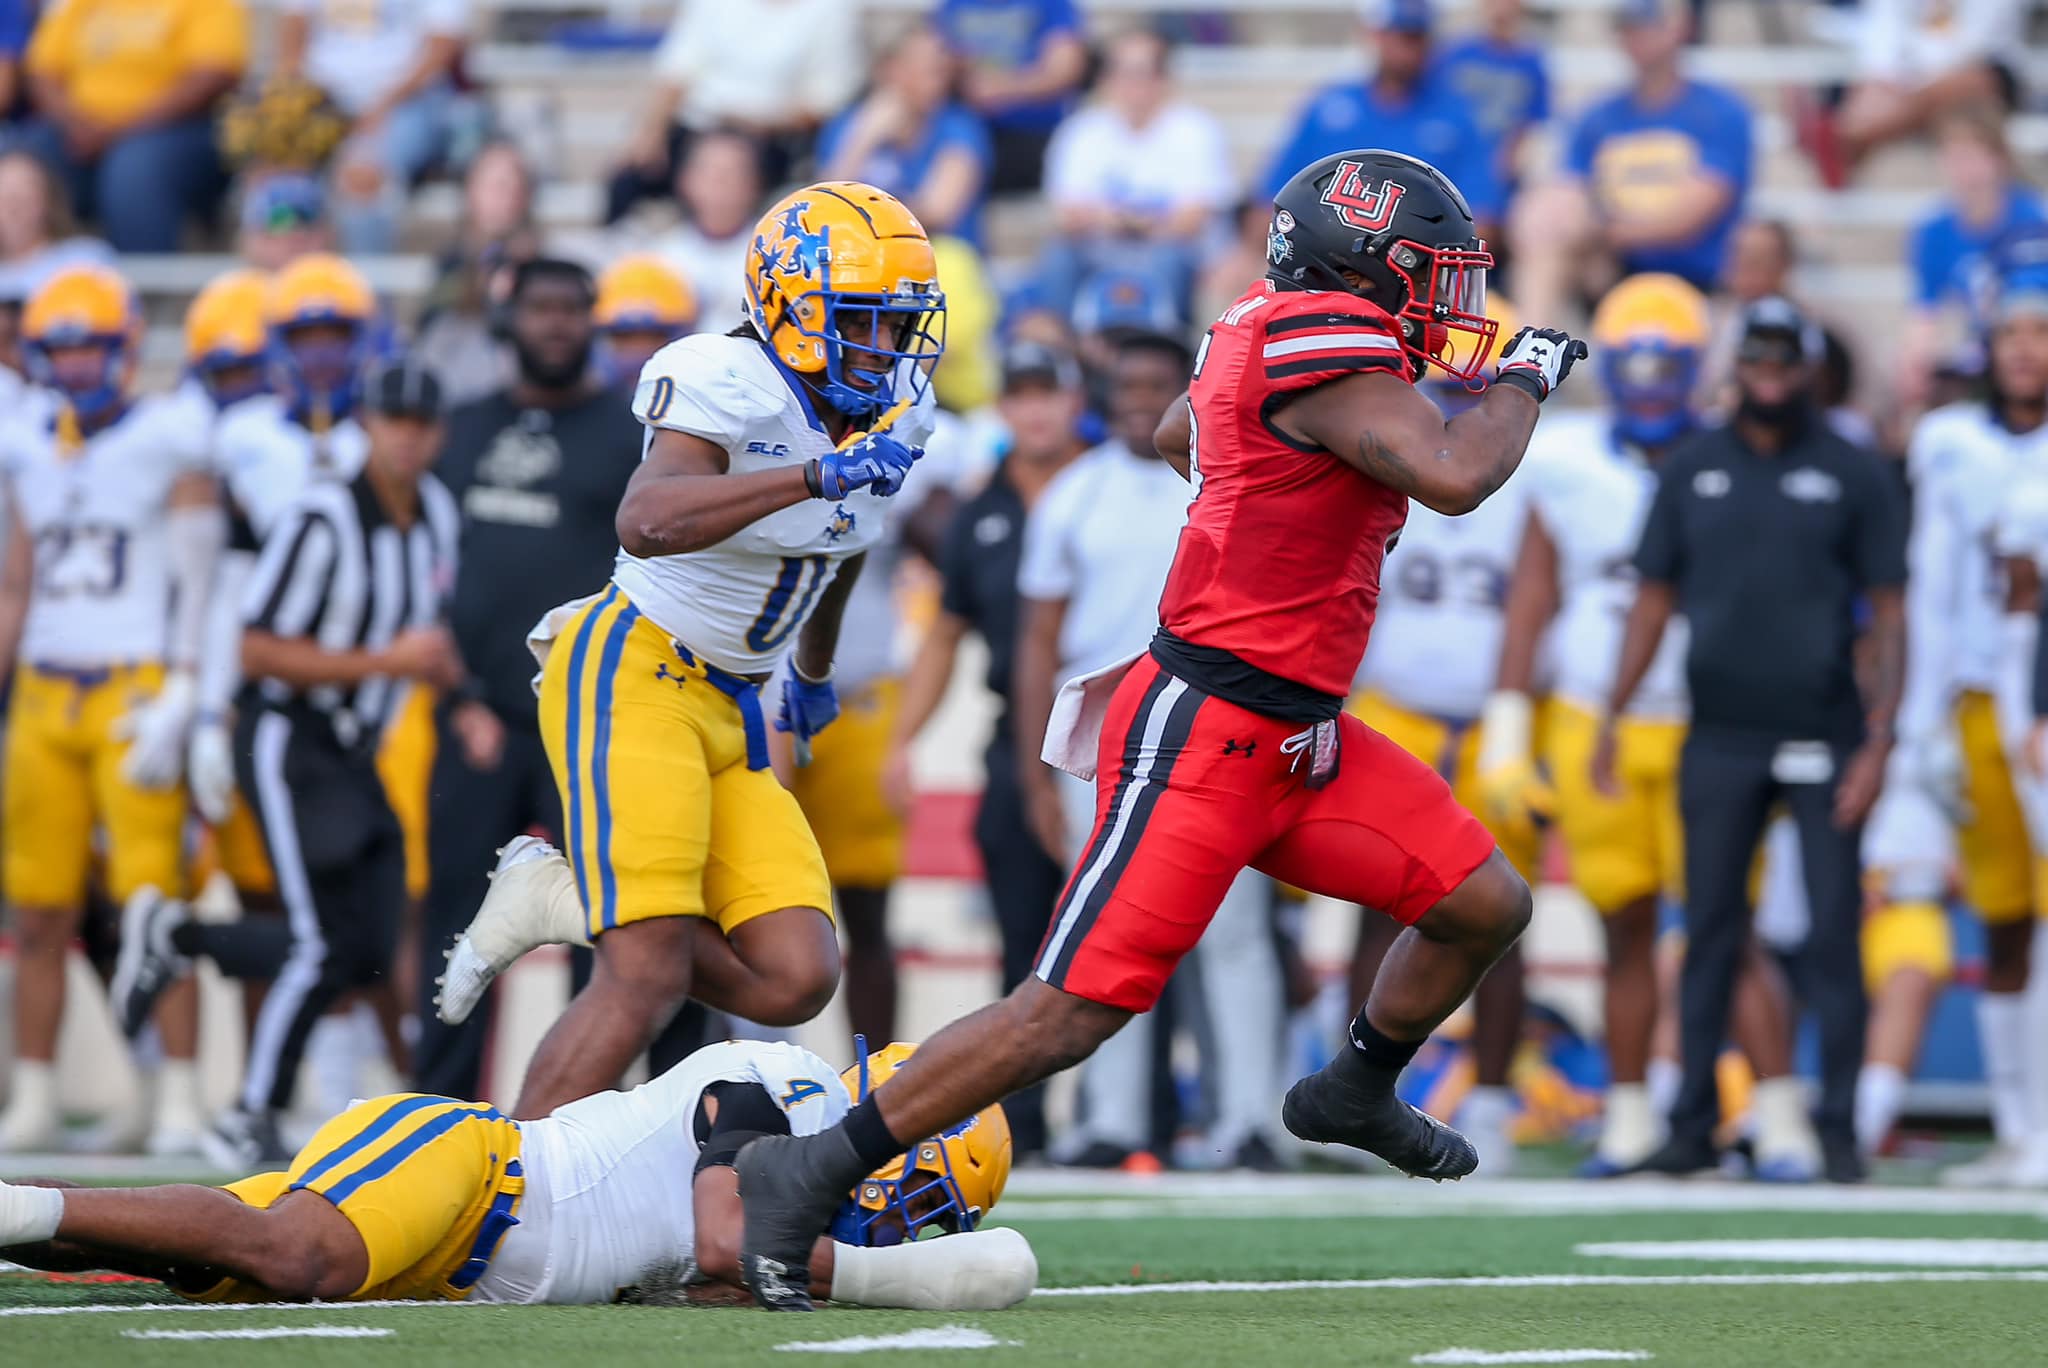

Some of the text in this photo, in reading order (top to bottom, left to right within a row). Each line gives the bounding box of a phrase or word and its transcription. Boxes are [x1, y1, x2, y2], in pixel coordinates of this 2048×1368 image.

[1320, 160, 1407, 234] LU
[647, 376, 675, 424] 0
[746, 441, 790, 457] SLC
[780, 1077, 829, 1112] 4
